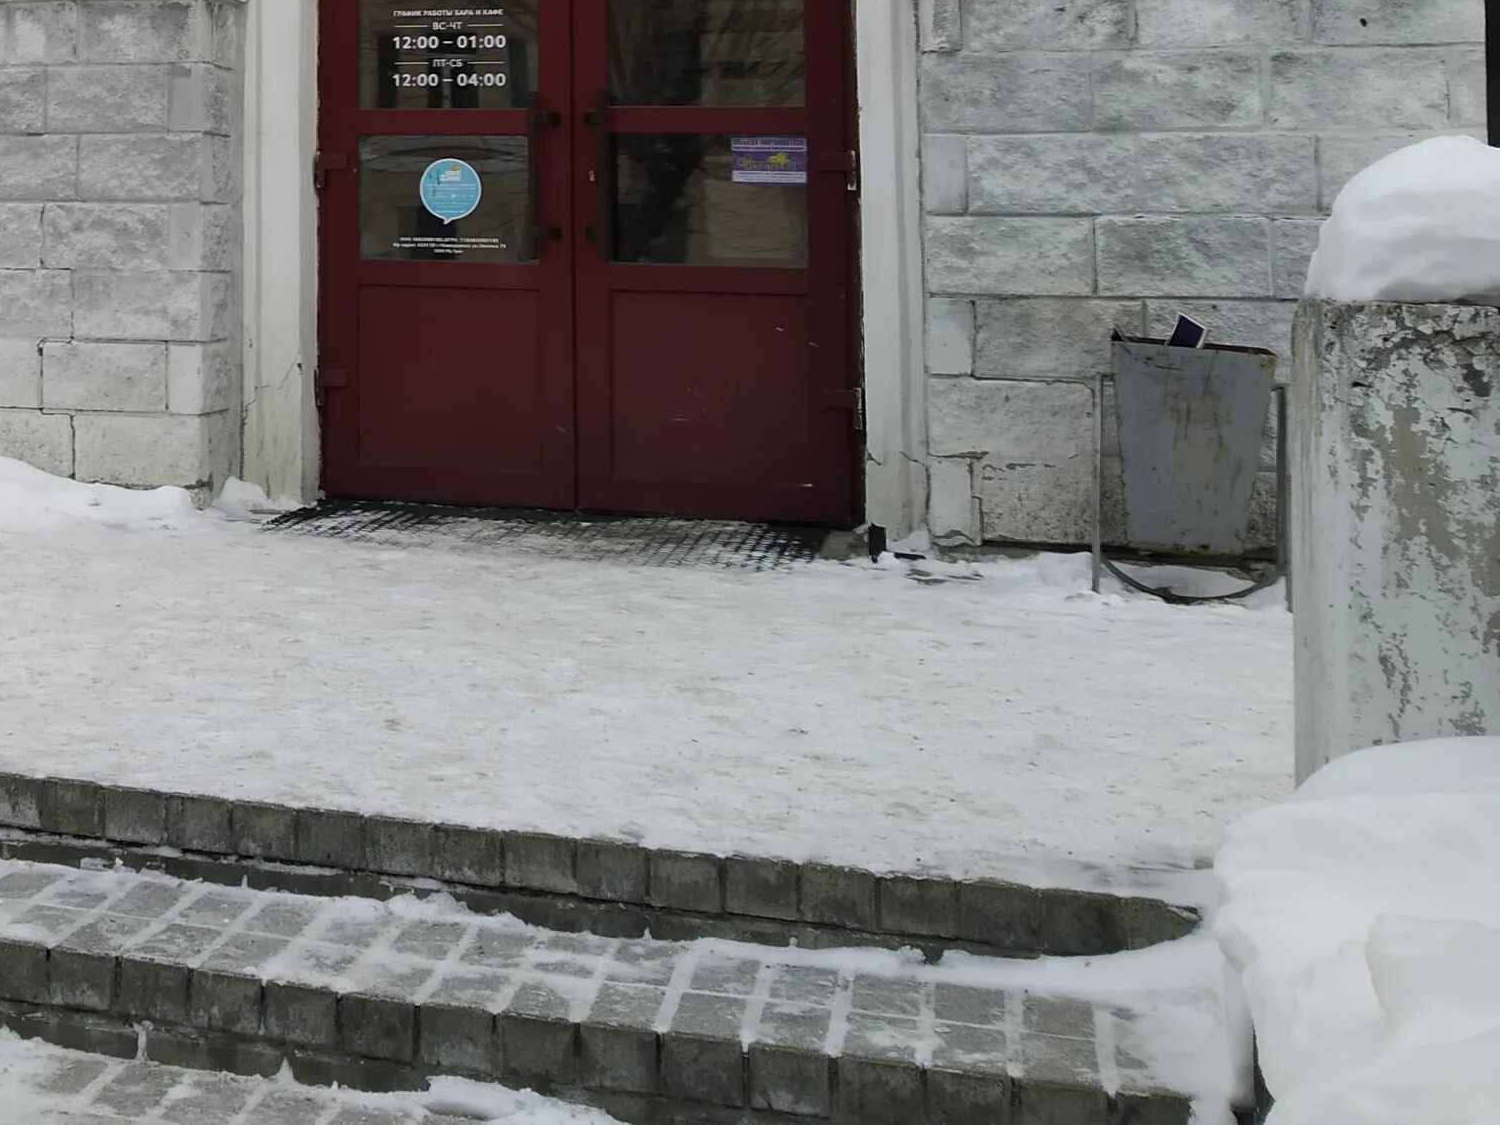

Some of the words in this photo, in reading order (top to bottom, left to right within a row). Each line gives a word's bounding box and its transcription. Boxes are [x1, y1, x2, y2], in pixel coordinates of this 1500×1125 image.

[423, 9, 453, 17] РАБОТЫ
[432, 21, 463, 30] ВС-ЧТ
[392, 35, 439, 49] 12:00
[456, 35, 507, 49] 01:00
[432, 59, 464, 68] ПТ-СБ
[392, 73, 439, 87] 12:00
[456, 73, 507, 87] 04:00
